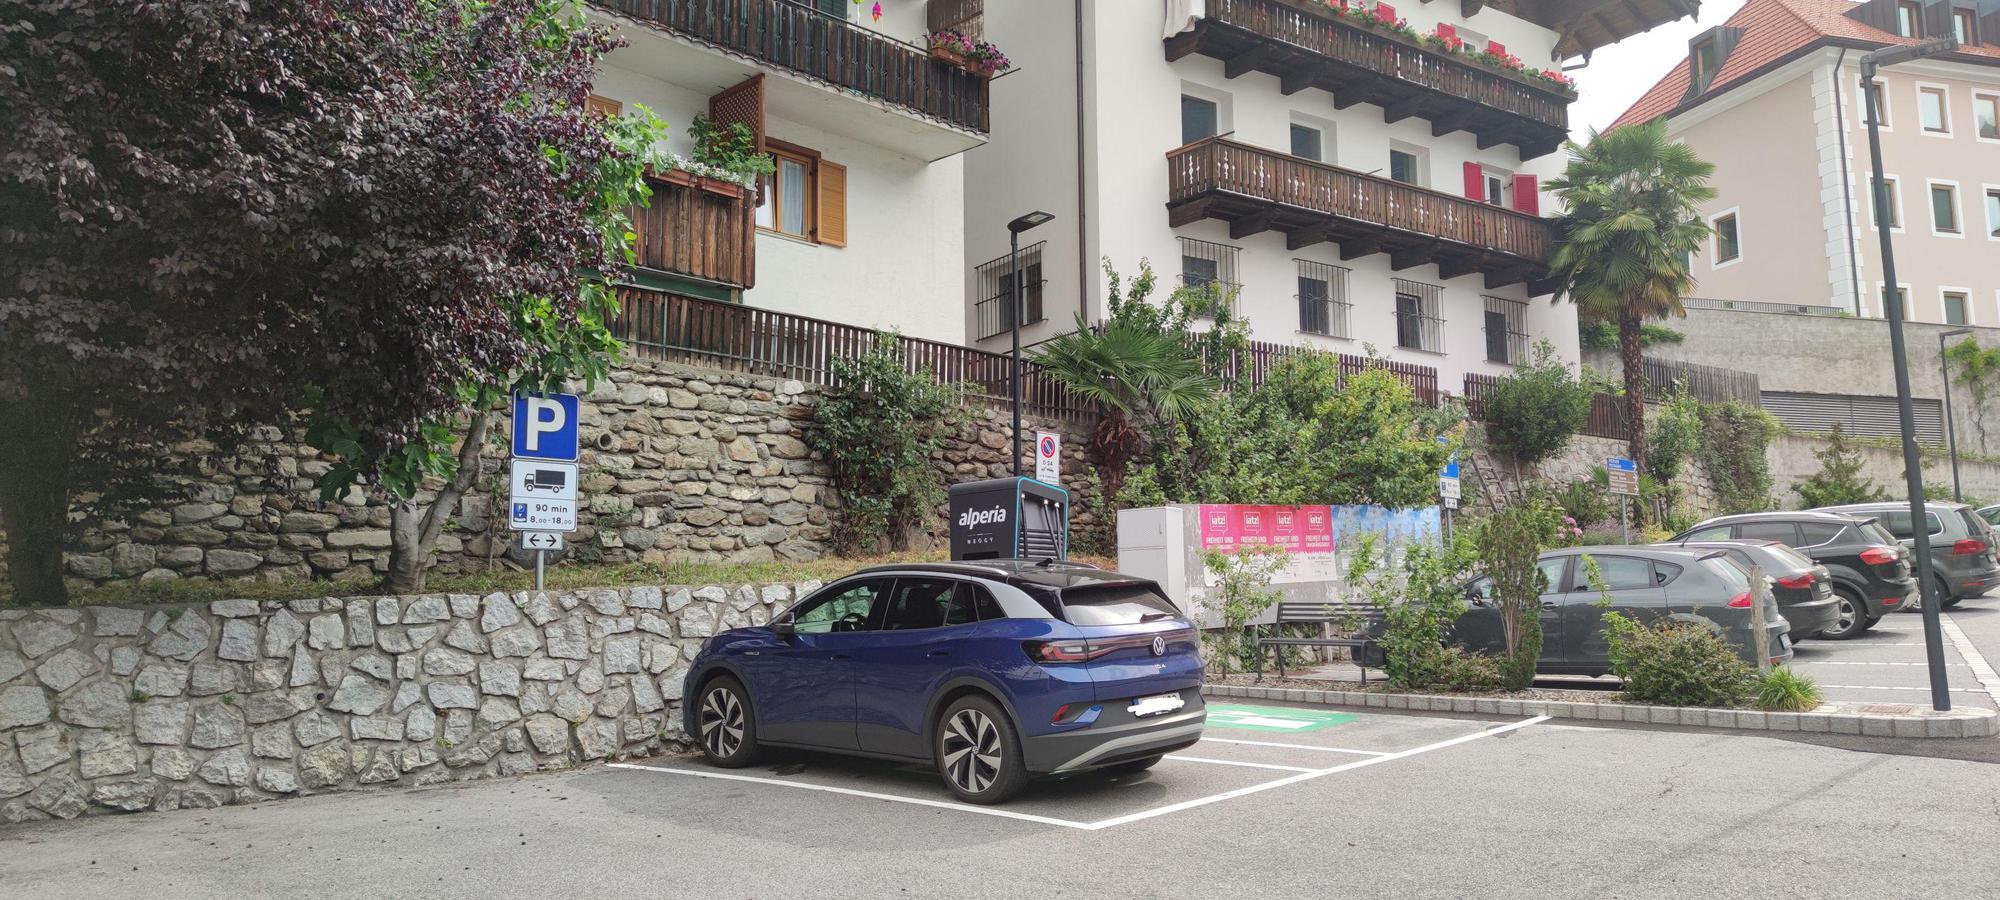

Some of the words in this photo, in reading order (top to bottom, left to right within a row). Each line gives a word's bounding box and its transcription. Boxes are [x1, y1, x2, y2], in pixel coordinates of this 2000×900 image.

[526, 397, 566, 451] P
[535, 504, 548, 512] 90
[551, 505, 568, 513] min
[959, 505, 1006, 529] alperia
